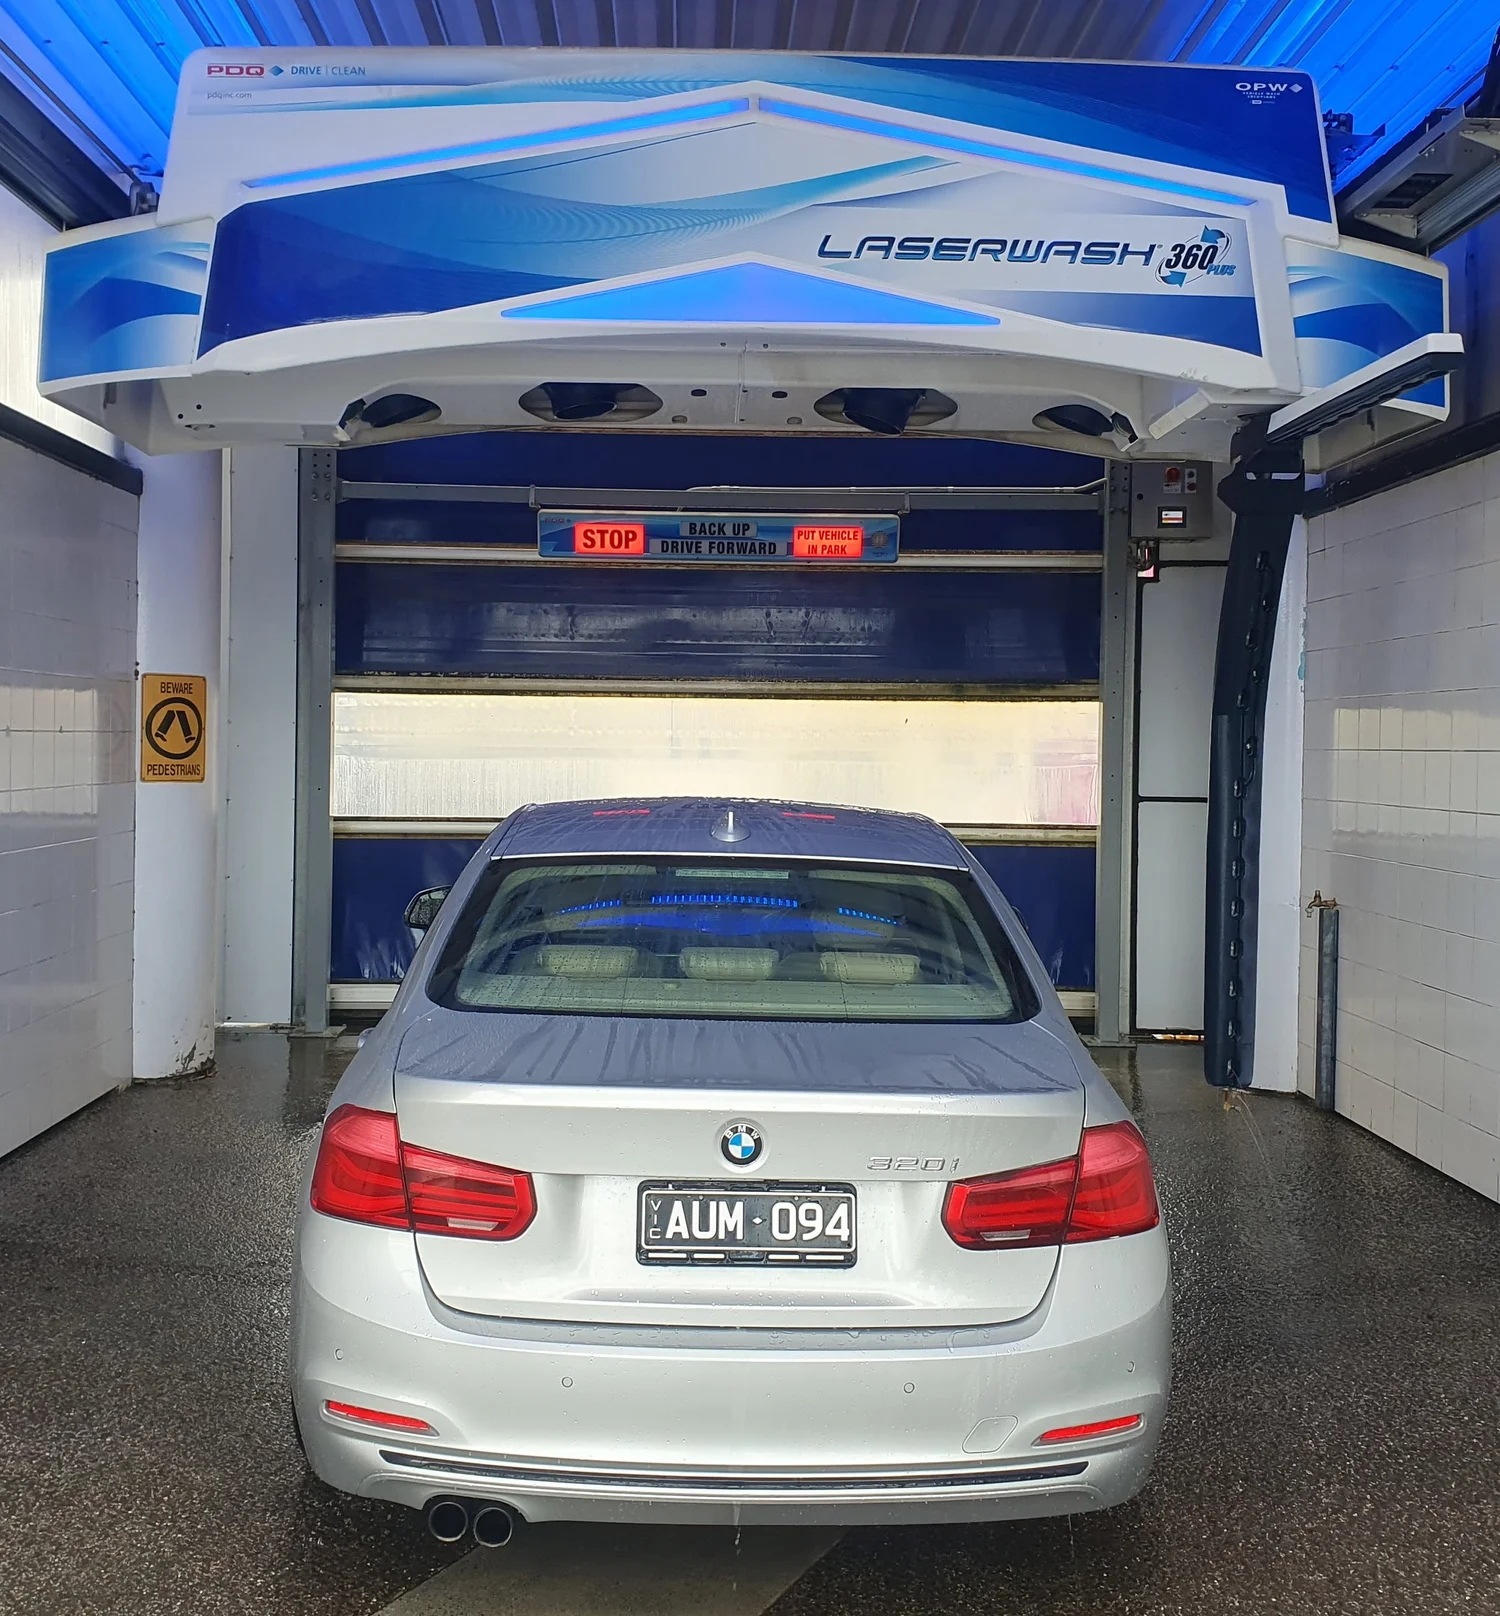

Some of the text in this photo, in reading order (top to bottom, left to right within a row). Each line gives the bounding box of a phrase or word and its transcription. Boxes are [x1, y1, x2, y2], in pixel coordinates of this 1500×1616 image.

[207, 65, 366, 76] PDQ DRIVE CLEAN
[1235, 82, 1288, 92] OPW
[817, 234, 1219, 270] LASERWASH 360
[1206, 264, 1236, 276] PLUS
[689, 522, 750, 536] BACK UP
[797, 530, 858, 540] PUT VEHICLE
[582, 529, 637, 549] STOP
[660, 540, 777, 555] DRIVE FORWARD
[807, 544, 847, 555] IN PARK
[160, 682, 193, 694] BEWARE
[147, 764, 200, 776] PEDESTRIANS
[724, 1125, 760, 1139] BMW
[867, 1156, 960, 1173] 320i
[650, 1200, 662, 1239] VIC
[665, 1200, 850, 1241] AUM 094
